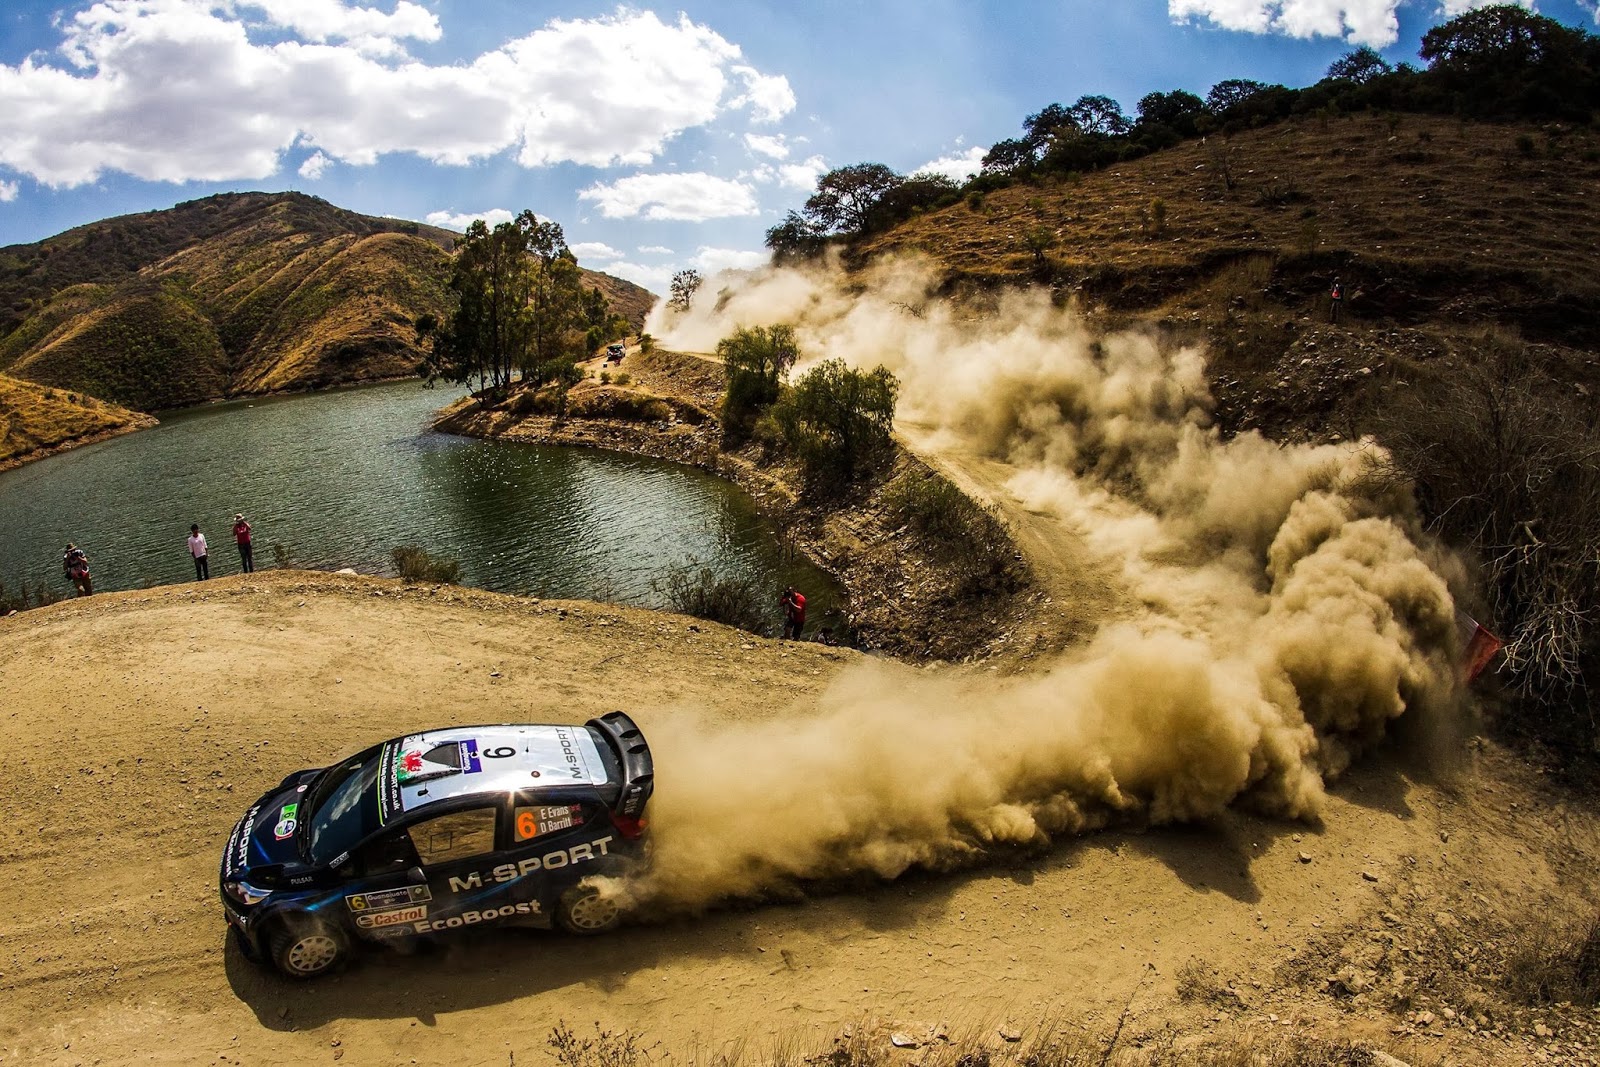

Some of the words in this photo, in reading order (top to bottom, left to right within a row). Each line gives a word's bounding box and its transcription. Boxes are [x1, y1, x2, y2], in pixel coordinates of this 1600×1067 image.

[483, 747, 516, 759] 6
[555, 728, 582, 779] M-SPORT
[541, 808, 547, 820] E
[547, 806, 569, 818] Evans
[517, 811, 537, 839] 6
[540, 822, 547, 833] D
[547, 817, 572, 832] Barritt
[448, 835, 613, 893] M-SPORT
[351, 896, 366, 911] 6
[367, 890, 408, 901] Guanajuato
[374, 908, 424, 926] Castrol
[413, 899, 542, 934] EcoBoost
